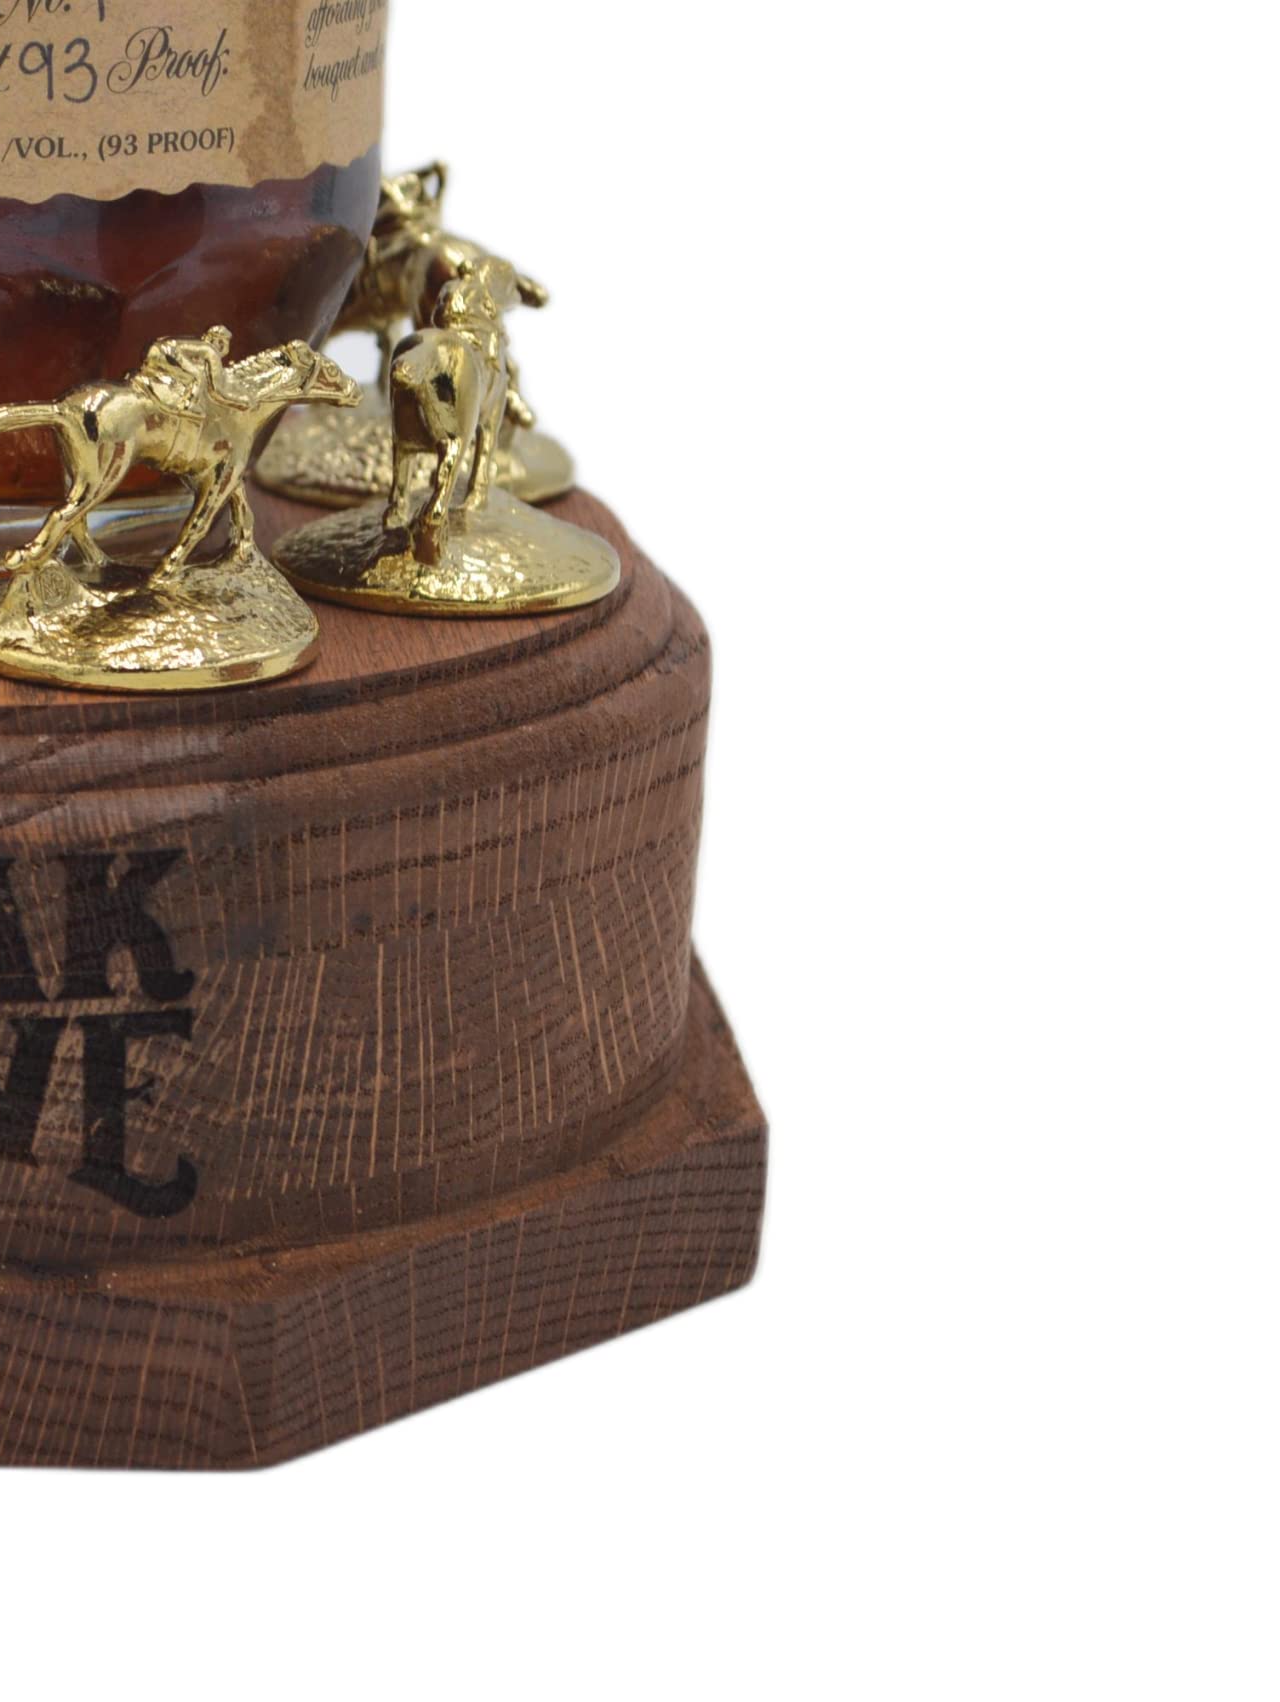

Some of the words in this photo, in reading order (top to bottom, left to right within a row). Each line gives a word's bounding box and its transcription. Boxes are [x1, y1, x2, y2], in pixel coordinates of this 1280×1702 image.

[19, 37, 98, 103] 93
[303, 46, 361, 103] bouquet
[97, 131, 138, 162] (93
[146, 126, 236, 155] PROOF)
